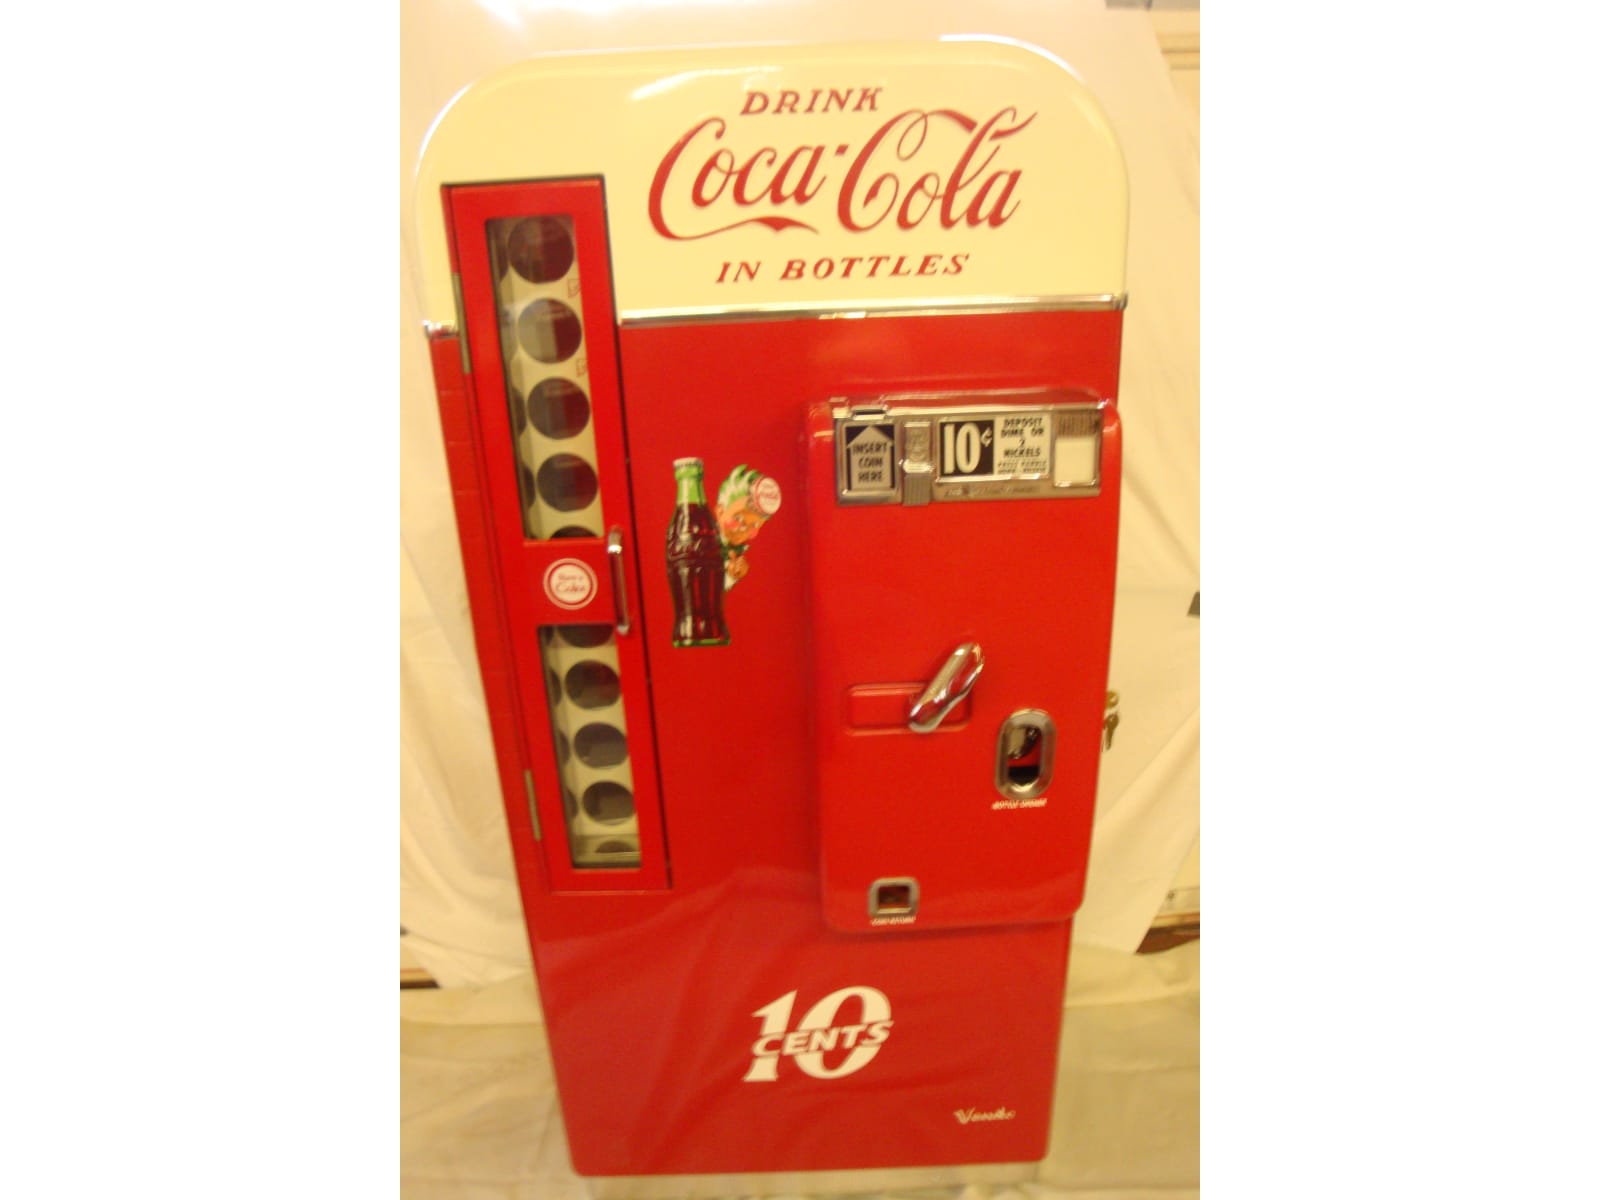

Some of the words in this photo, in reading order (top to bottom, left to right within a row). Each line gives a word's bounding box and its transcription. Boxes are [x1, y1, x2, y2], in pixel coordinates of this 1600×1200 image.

[739, 87, 884, 116] DRINK
[648, 106, 1038, 241] Coca-Cola
[715, 261, 762, 284] IN
[779, 253, 970, 281] BOTTLES
[852, 441, 888, 455] INSERT
[858, 456, 883, 468] COIN
[857, 470, 882, 482] HERE
[741, 985, 893, 1083] 10
[752, 1020, 895, 1056] CENTS
